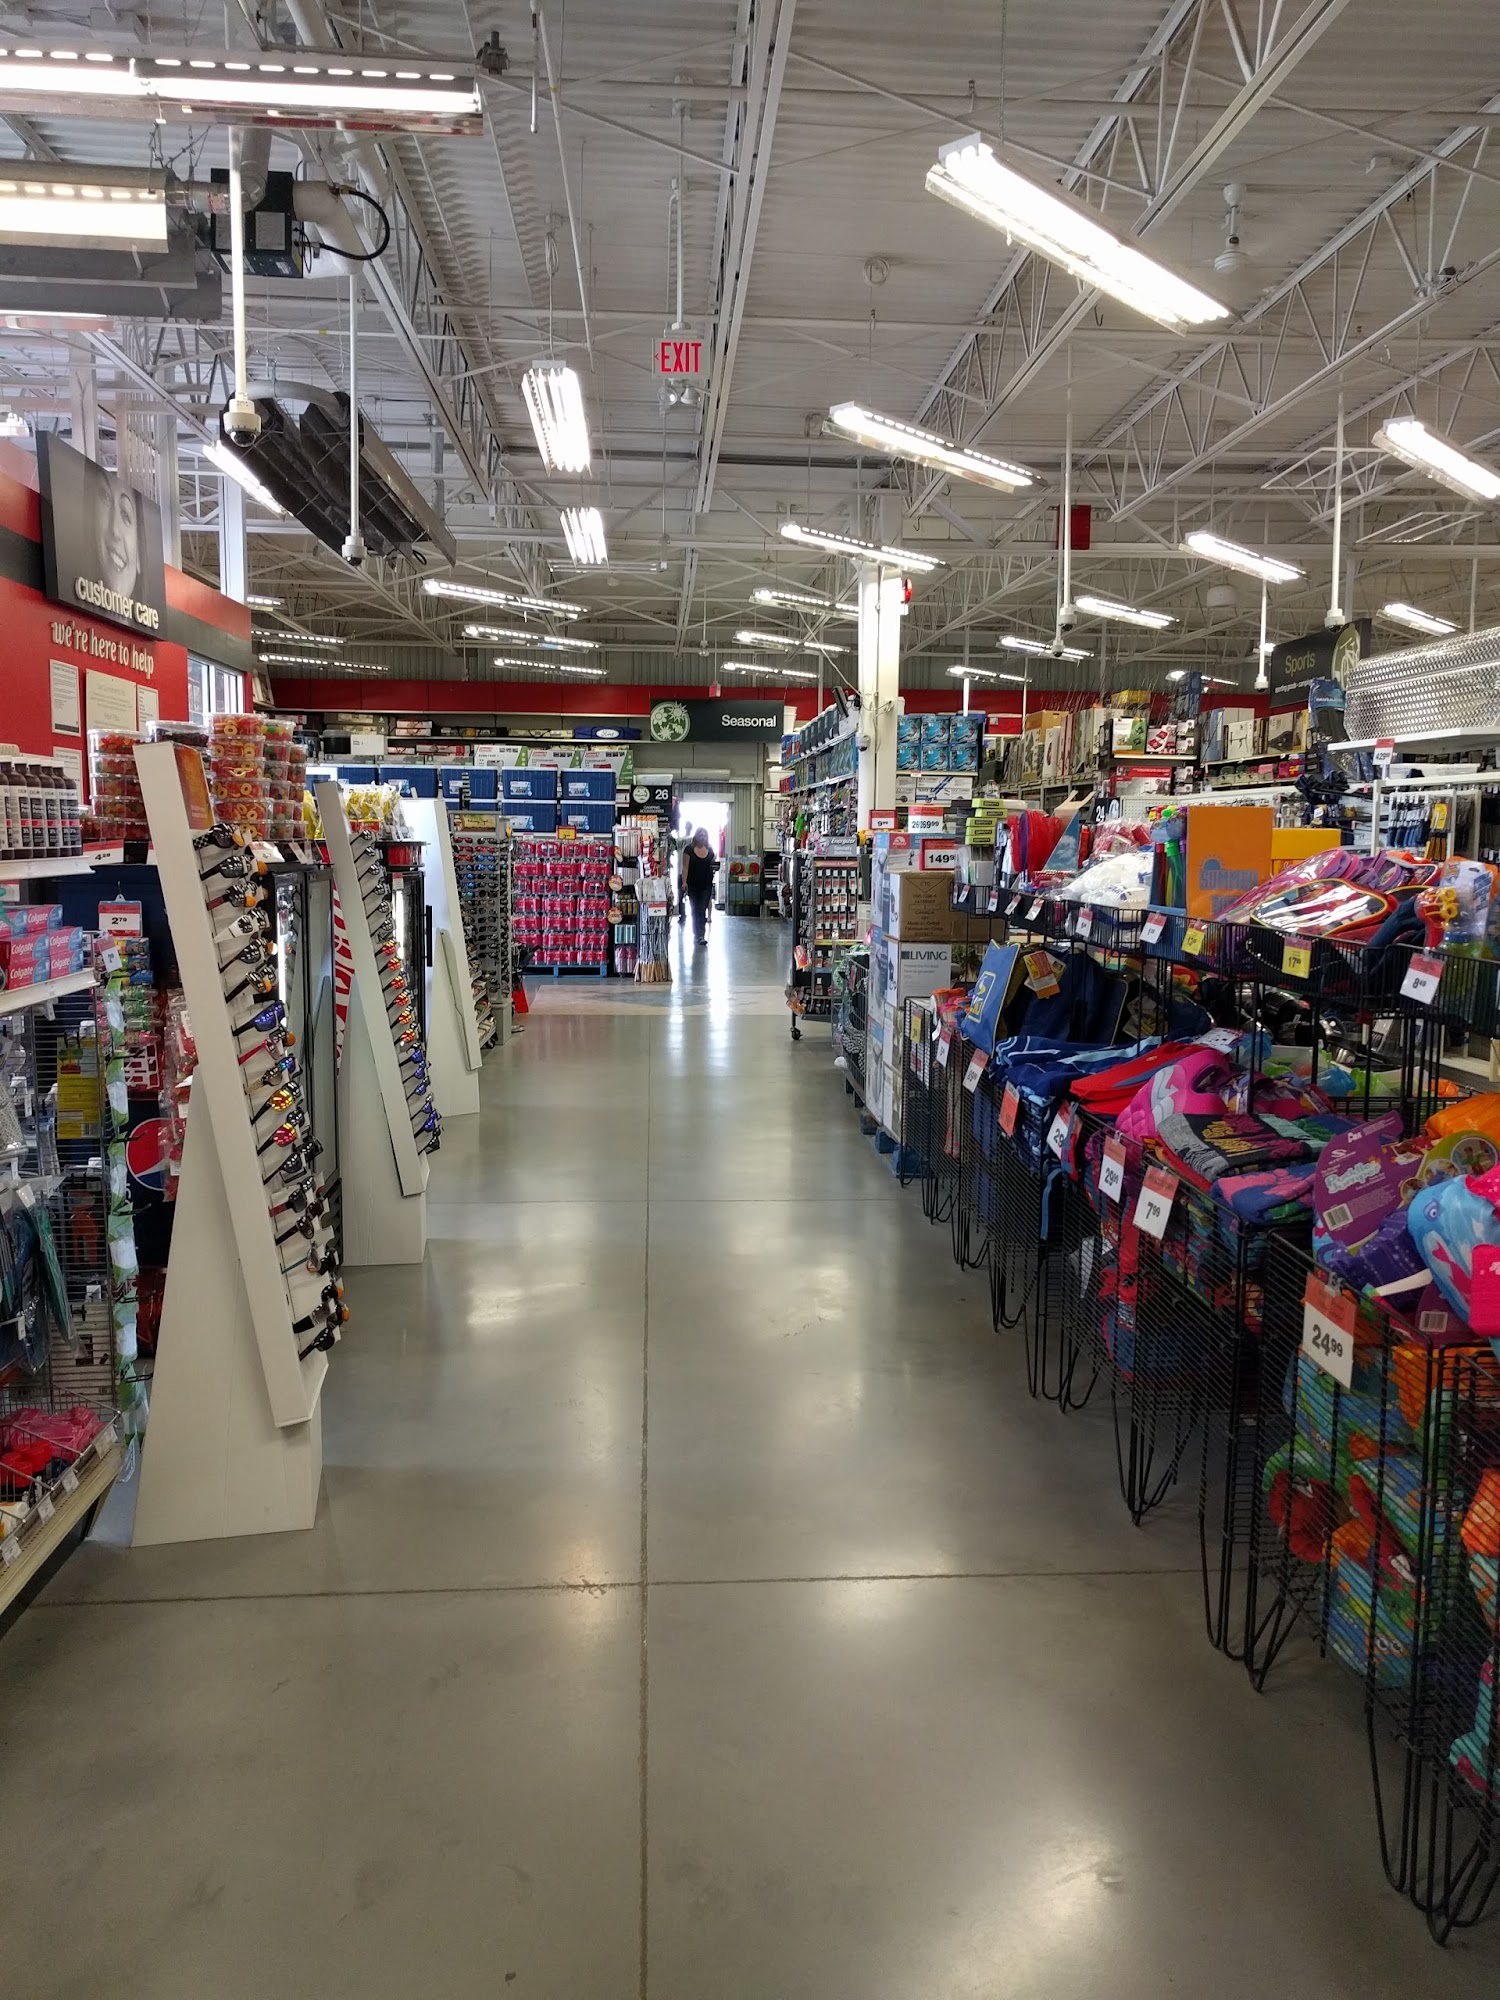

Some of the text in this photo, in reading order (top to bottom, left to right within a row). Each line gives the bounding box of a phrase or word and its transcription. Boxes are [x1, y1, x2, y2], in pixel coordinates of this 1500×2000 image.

[661, 342, 702, 373] EXIT
[76, 577, 159, 630] customer care
[51, 620, 154, 680] we're here to help
[1285, 651, 1316, 678] Sports
[721, 714, 777, 728] Seasonal
[655, 788, 669, 800] 26
[1095, 805, 1105, 822] 24
[830, 837, 856, 846] Energizer
[28, 912, 48, 925] Colgate
[111, 917, 128, 925] 279
[49, 935, 70, 947] Colgate
[12, 942, 34, 955] Colgate
[910, 950, 948, 961] LIVING
[51, 957, 70, 970] Colgate
[10, 966, 34, 980] Colgate
[1053, 1128, 1065, 1148] 29
[1145, 1201, 1161, 1220] 799
[1311, 1324, 1343, 1358] 2499
